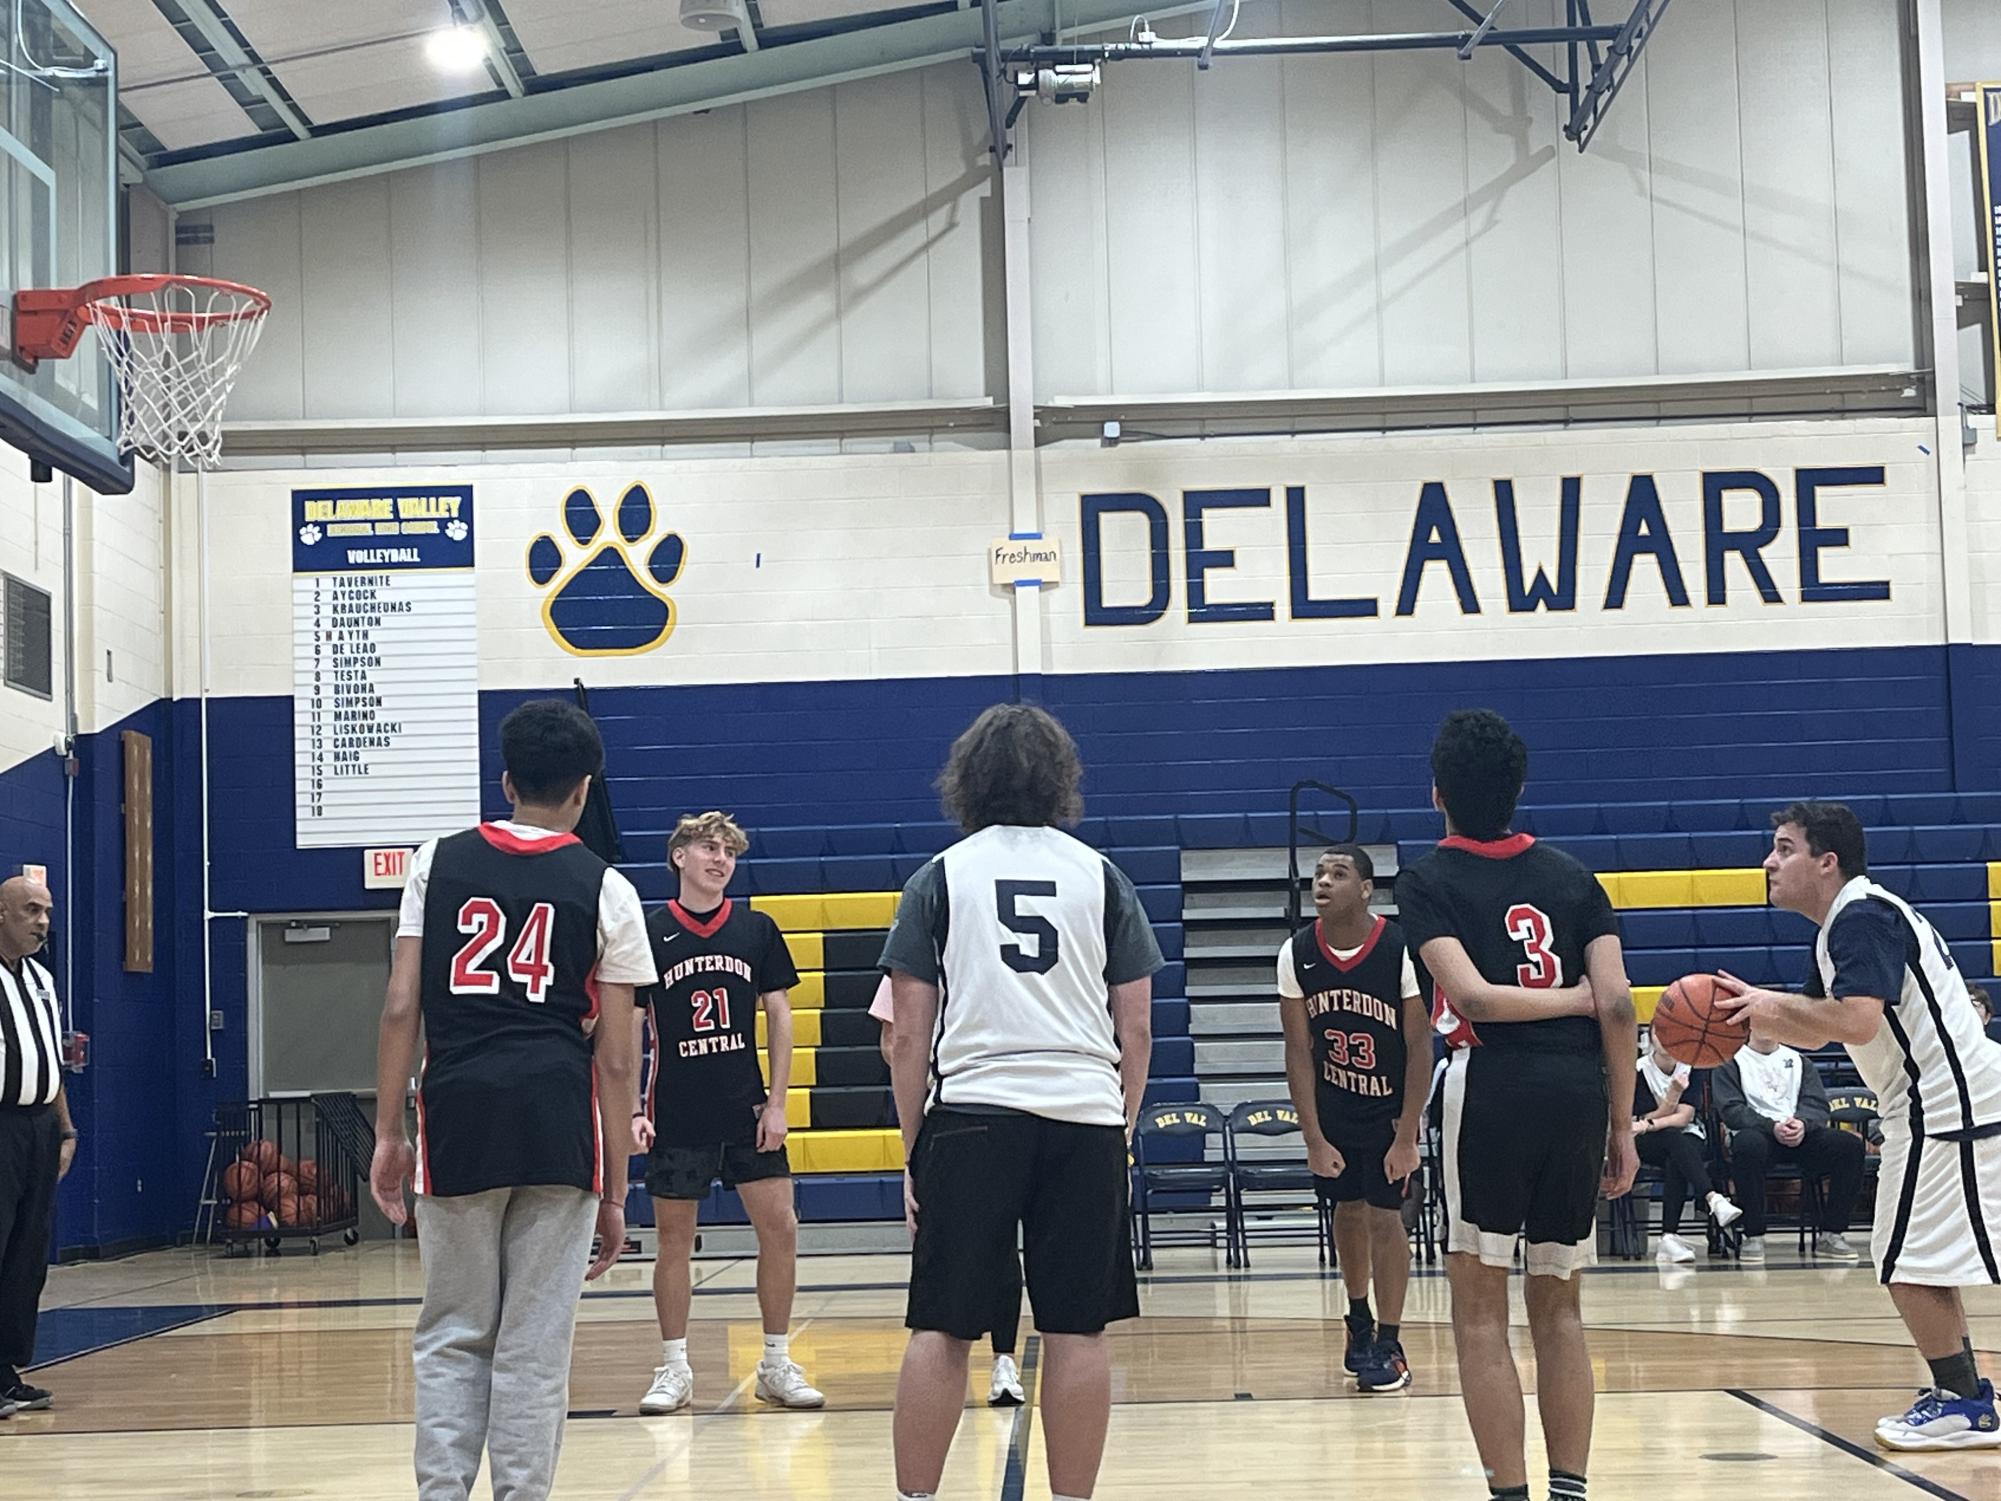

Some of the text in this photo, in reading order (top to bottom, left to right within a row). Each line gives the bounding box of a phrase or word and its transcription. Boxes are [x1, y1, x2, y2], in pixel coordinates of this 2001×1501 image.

[304, 496, 462, 522] DELAWARE VALLEY
[1079, 465, 1893, 629] DELAWARE
[347, 548, 421, 564] VOLLEYBALL
[995, 545, 1057, 564] Freshman
[315, 576, 391, 588] 1 TAVERNITE
[314, 590, 377, 602] 2 AYCOCK
[314, 604, 320, 615] 3
[314, 616, 382, 628] 4 DAUNTON
[314, 631, 320, 642] 5
[314, 644, 321, 656] 6
[332, 644, 345, 655] DE
[314, 656, 382, 668] 7 SIMPSON
[314, 670, 367, 682] 8 TESTA
[314, 685, 320, 696] 9
[312, 696, 382, 709] 10 SIMPSON
[312, 710, 376, 722] 11 MARINO
[311, 722, 402, 736] 12 LISKOWACKI
[312, 736, 390, 750] 13 CARDENAS
[312, 752, 324, 763] 14
[312, 764, 370, 776] 15 LITTLE
[312, 778, 322, 790] 16
[311, 792, 322, 803] 17
[312, 806, 322, 816] 18
[374, 852, 405, 876] EXIT
[994, 879, 1059, 974] 5
[449, 897, 556, 1004] 24
[1504, 903, 1563, 989] 3
[663, 955, 752, 990] HUNTERDON
[691, 987, 731, 1032] 21
[679, 1033, 746, 1057] CENTRAL
[1324, 1028, 1376, 1070] 33
[1155, 1111, 1207, 1128] DEL VAL
[1247, 1109, 1299, 1126] DEL VAL
